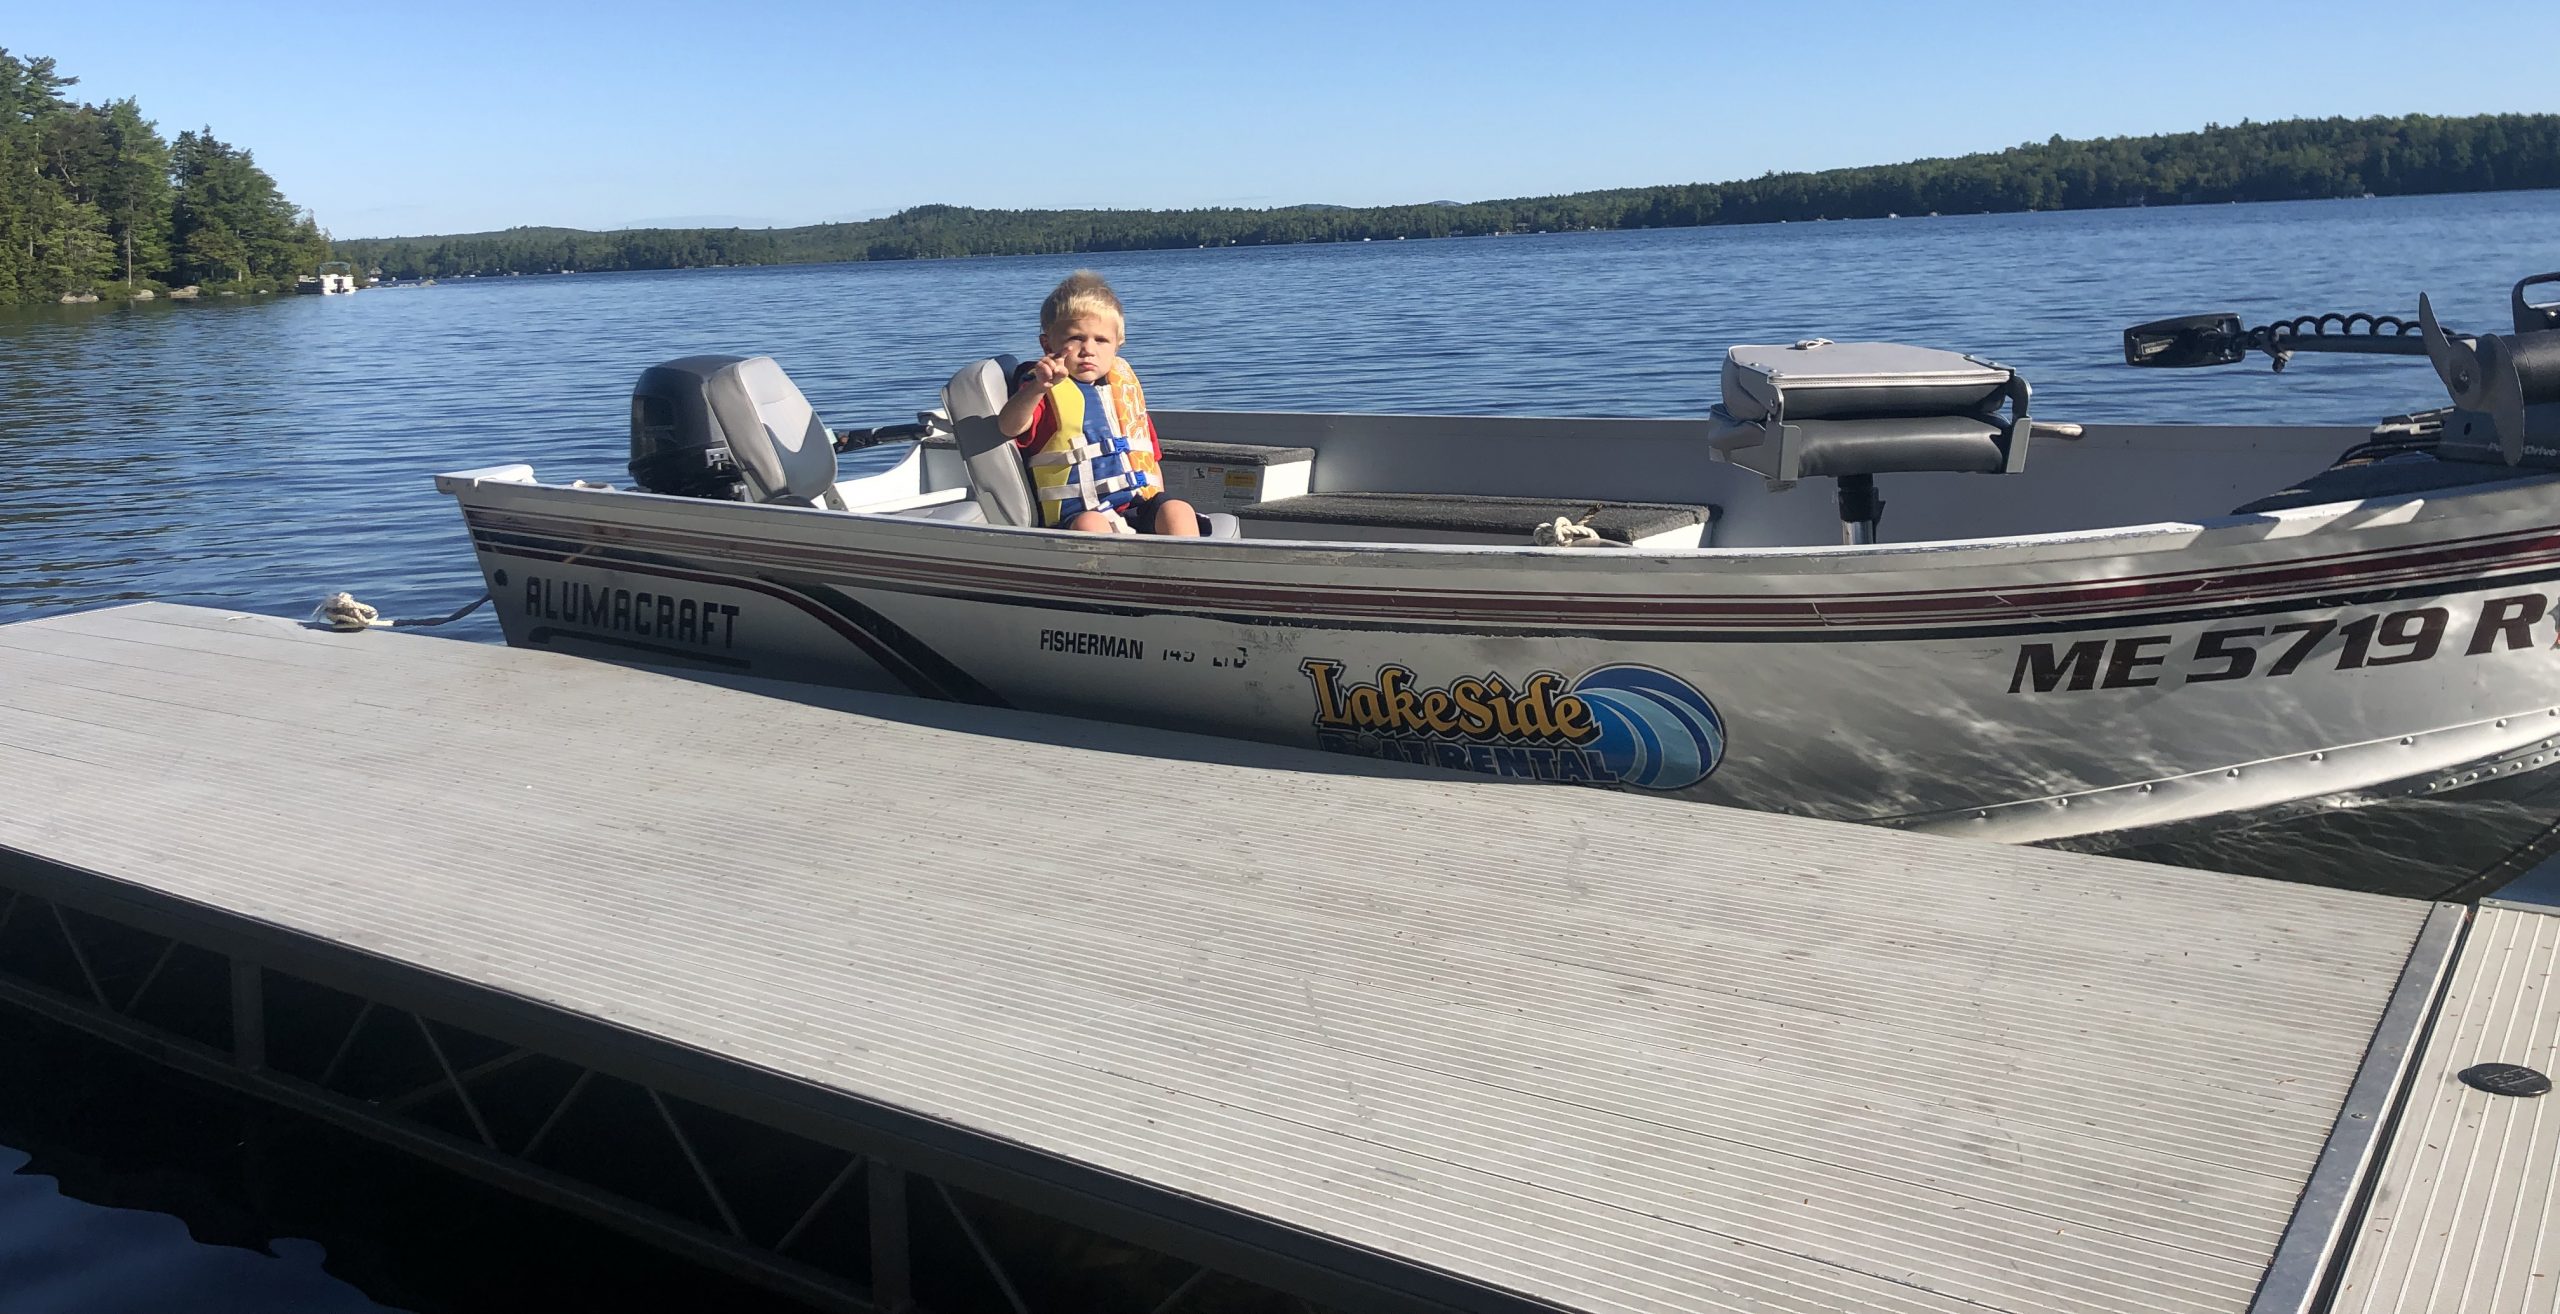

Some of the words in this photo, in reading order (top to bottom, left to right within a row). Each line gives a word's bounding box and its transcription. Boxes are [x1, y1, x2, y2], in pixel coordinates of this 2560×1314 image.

[525, 575, 741, 649] ALUMACRAFT
[1040, 628, 1144, 660] FISHERMAN
[2006, 635, 2172, 694] ME
[2185, 606, 2450, 684] 5719
[2463, 593, 2548, 656] R
[1300, 657, 1603, 746] LakeSide
[1432, 741, 1620, 784] RENTAL
